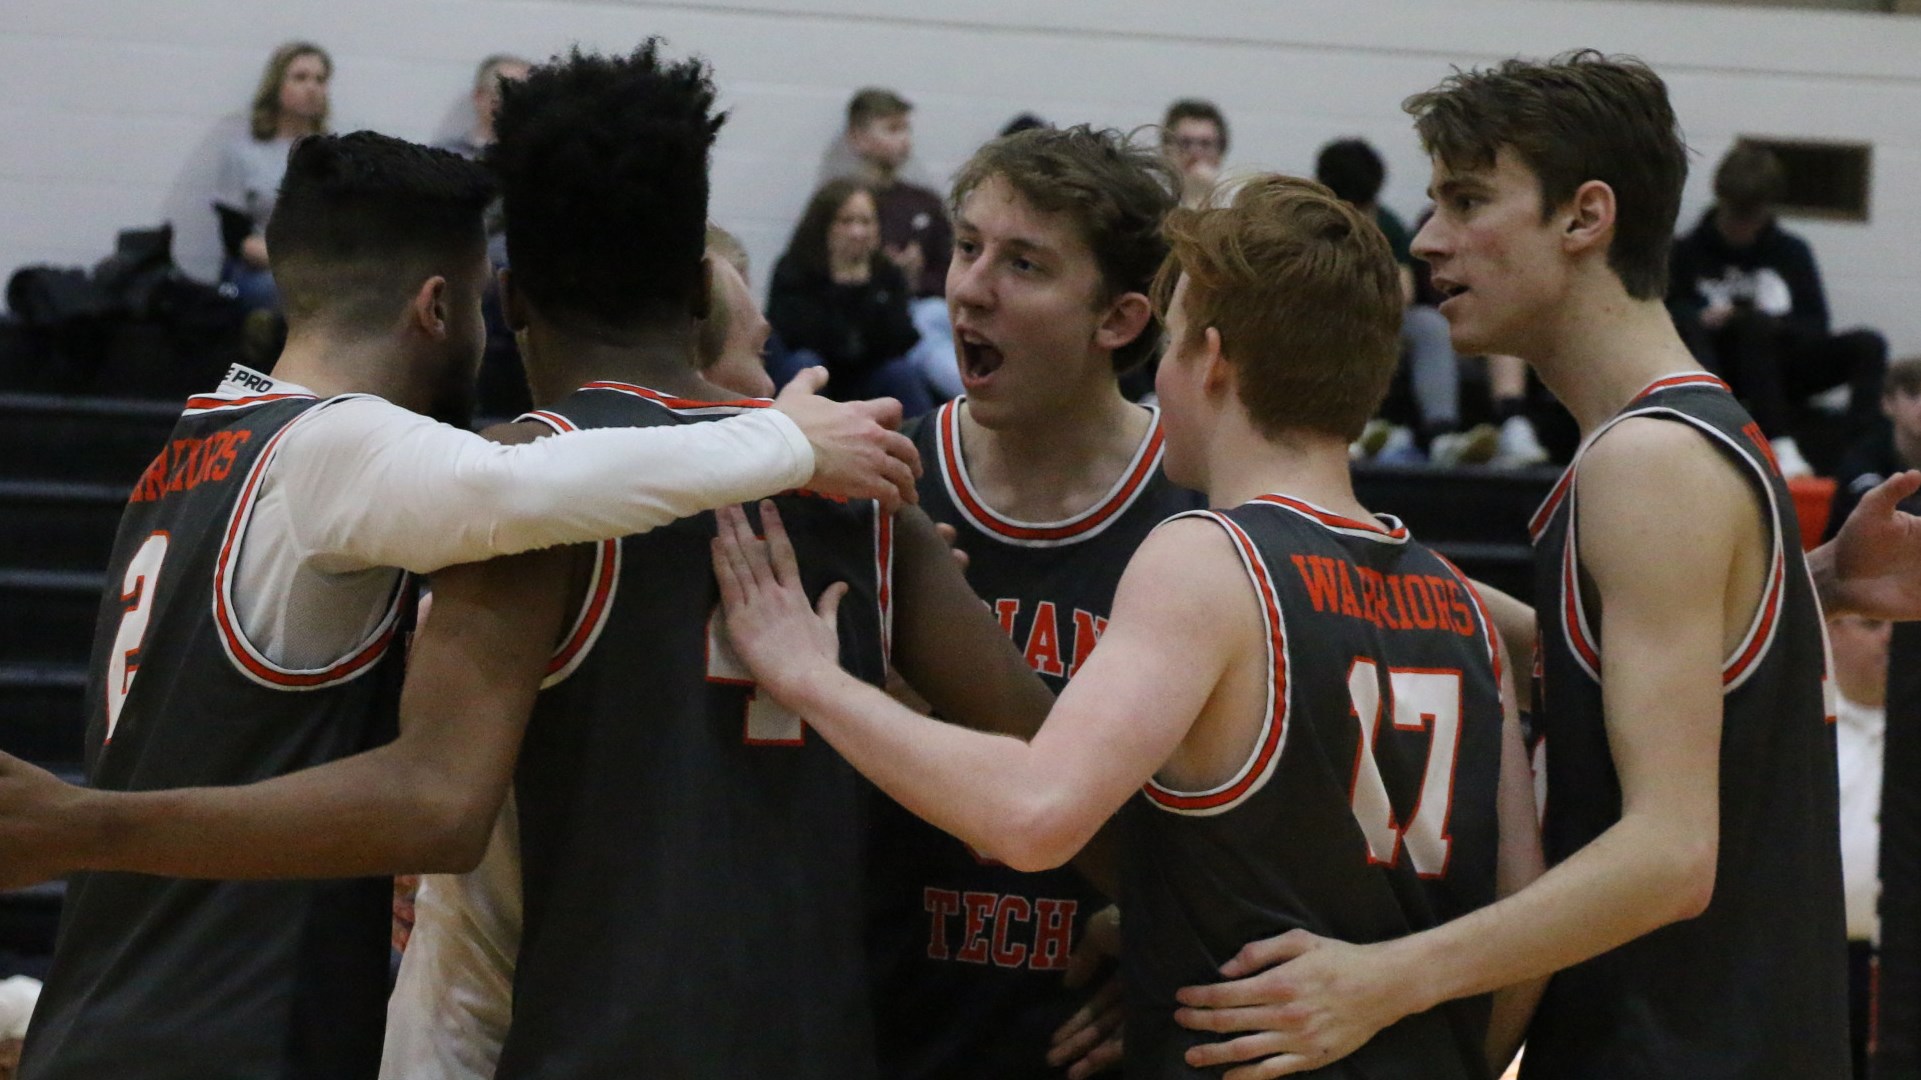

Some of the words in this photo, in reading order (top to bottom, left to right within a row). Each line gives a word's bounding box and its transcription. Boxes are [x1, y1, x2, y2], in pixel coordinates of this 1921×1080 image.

[231, 369, 274, 393] PRO
[104, 530, 171, 745] 2
[1290, 553, 1476, 637] WARRIORS
[1347, 655, 1464, 879] 17
[924, 886, 1078, 971] TECH
